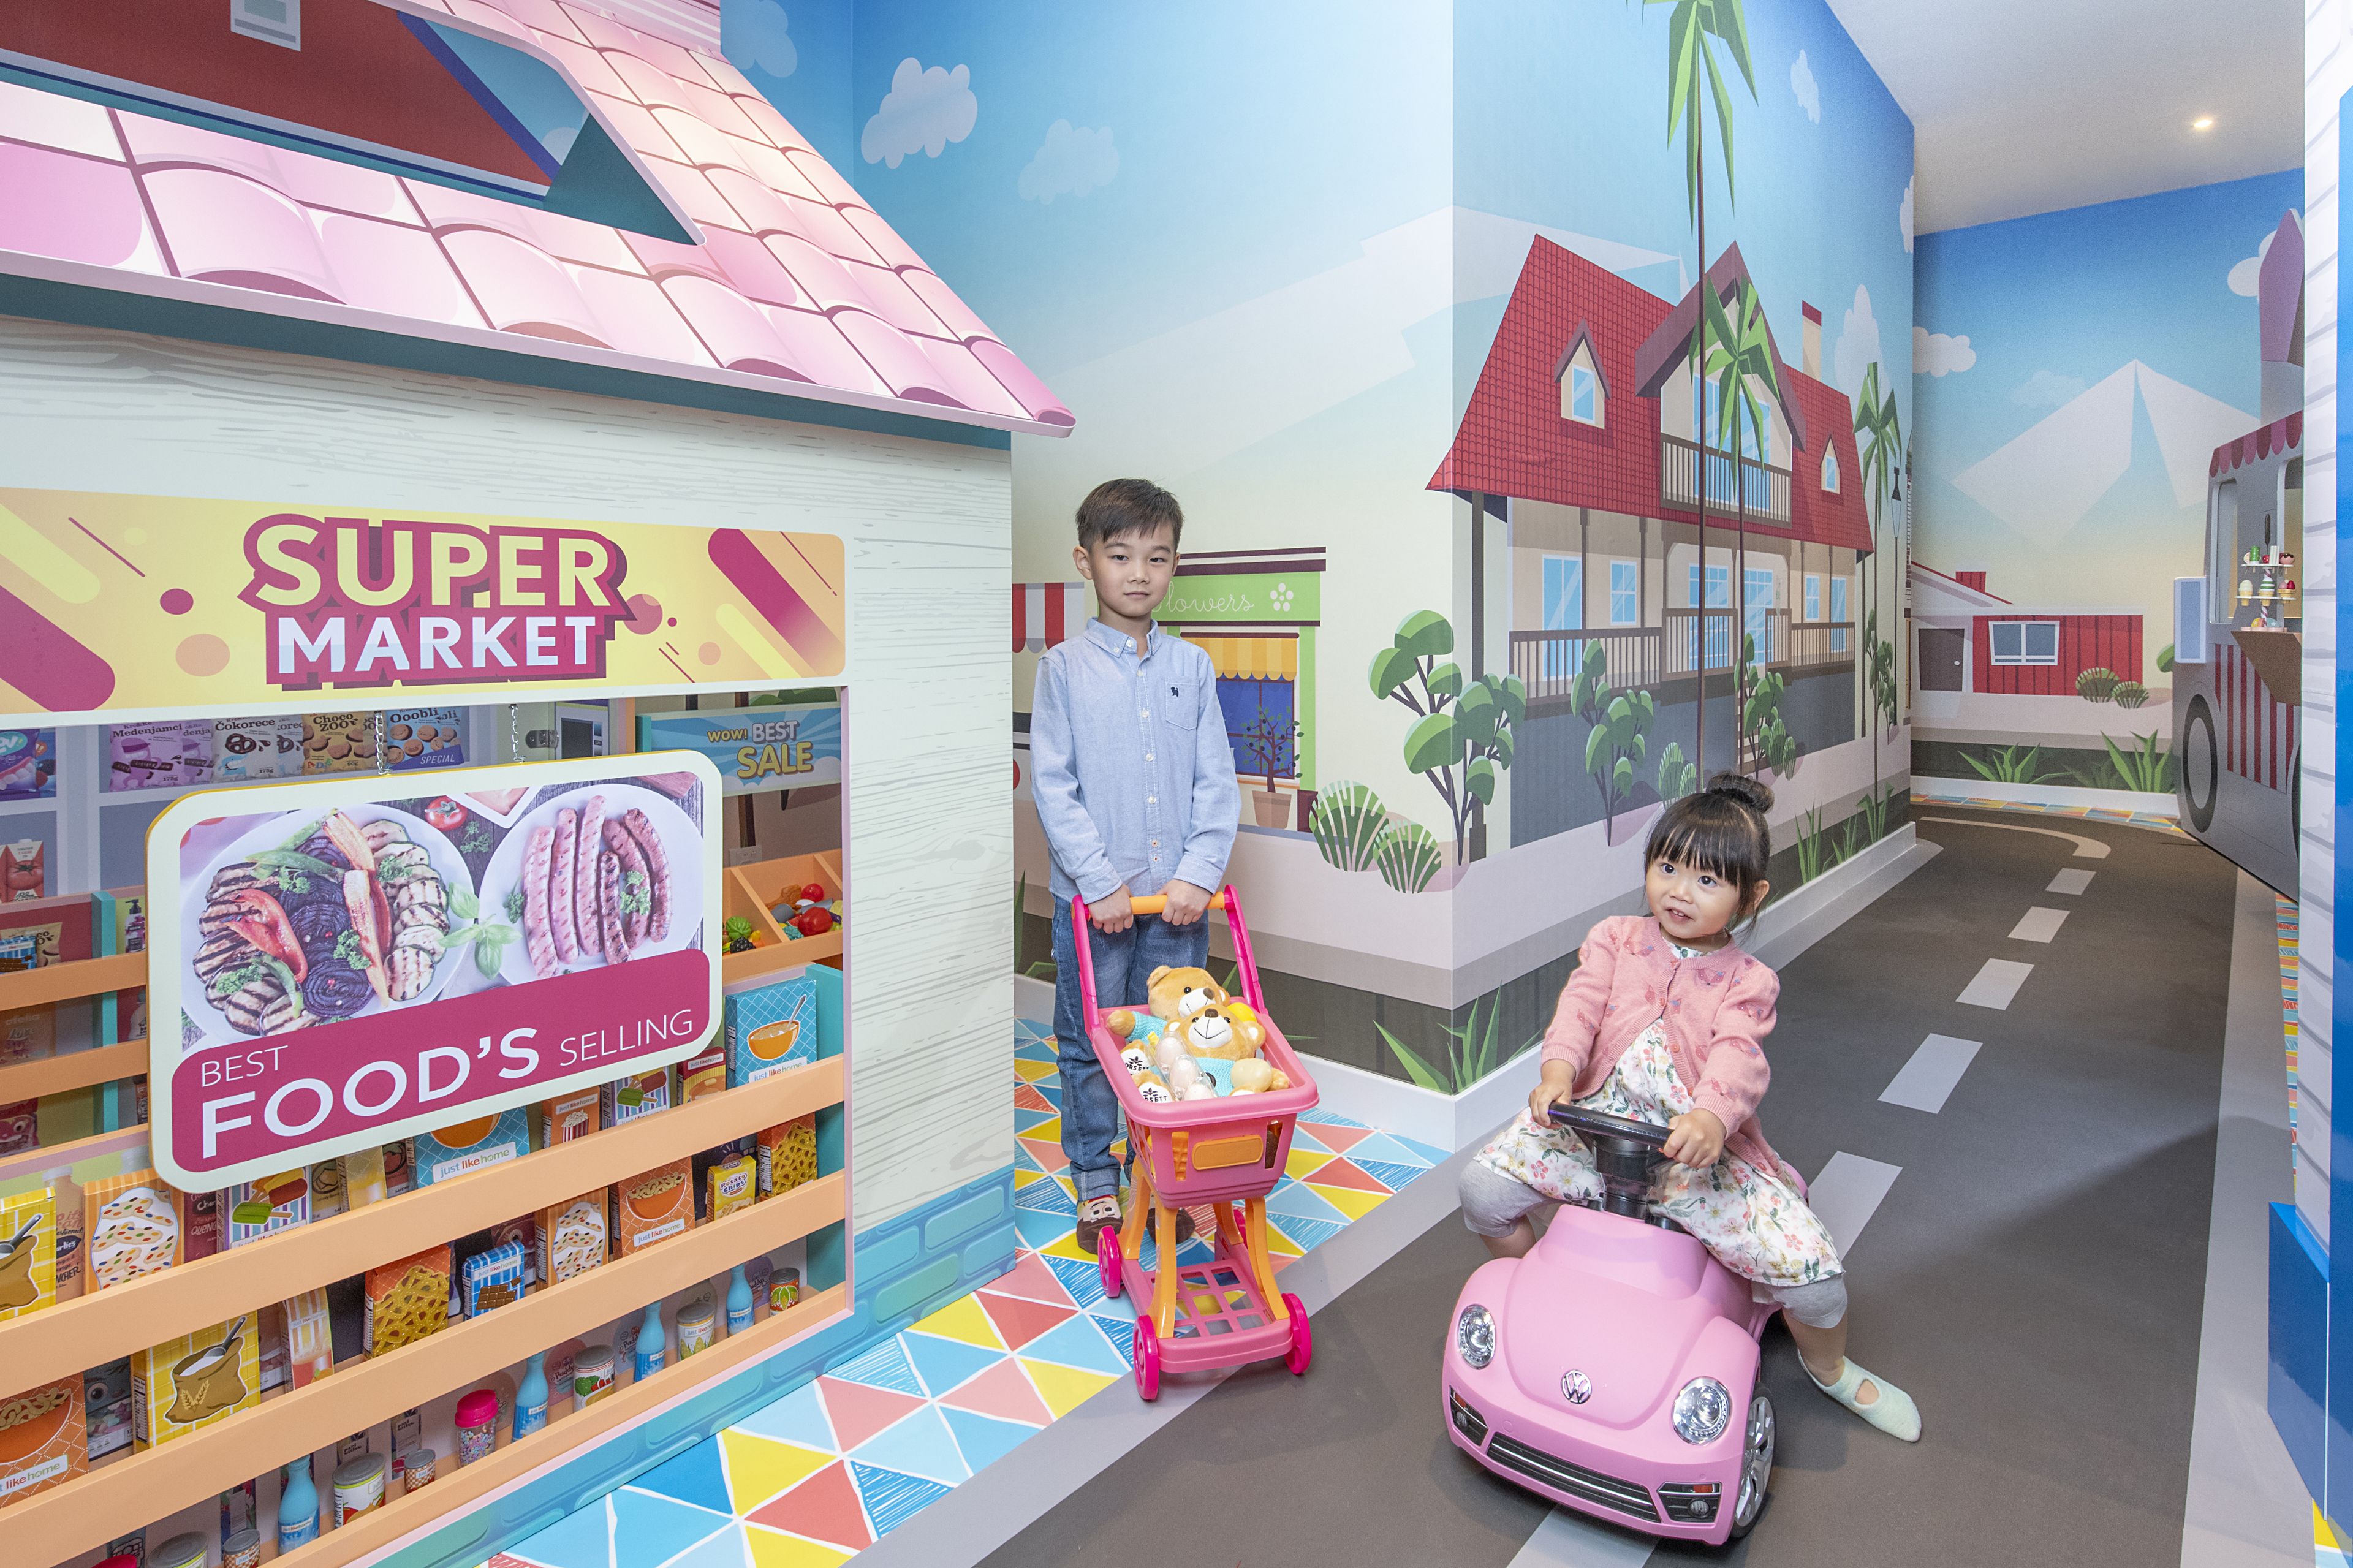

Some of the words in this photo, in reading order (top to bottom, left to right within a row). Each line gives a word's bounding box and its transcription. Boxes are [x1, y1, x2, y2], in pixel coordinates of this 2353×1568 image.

[254, 523, 613, 607] SUPER
[1152, 581, 1255, 612] lowers
[277, 615, 596, 675] MARKET
[215, 719, 275, 731] Čokorece
[313, 714, 354, 724] Choco
[390, 708, 439, 723] Ooobli
[112, 723, 183, 738] Medenjamci
[183, 727, 211, 737] denja
[319, 720, 349, 732] ZOO
[707, 729, 748, 743] WOW!
[751, 721, 800, 743] BEST
[420, 754, 455, 765] SPECIAL
[737, 741, 814, 779] SALE
[201, 1044, 289, 1088] BEST
[768, 1067, 782, 1077] like
[202, 1027, 540, 1159] FOOD'S
[559, 1008, 694, 1067] SELLING
[441, 1162, 460, 1178] just
[461, 1157, 480, 1170] like
[480, 1149, 510, 1164] home
[720, 1173, 746, 1189] Potato
[638, 1235, 651, 1244] just
[651, 1230, 662, 1238] like
[662, 1222, 681, 1233] home
[56, 1266, 81, 1283] NCHER
[6, 1476, 26, 1490] like
[27, 1463, 61, 1482] home
